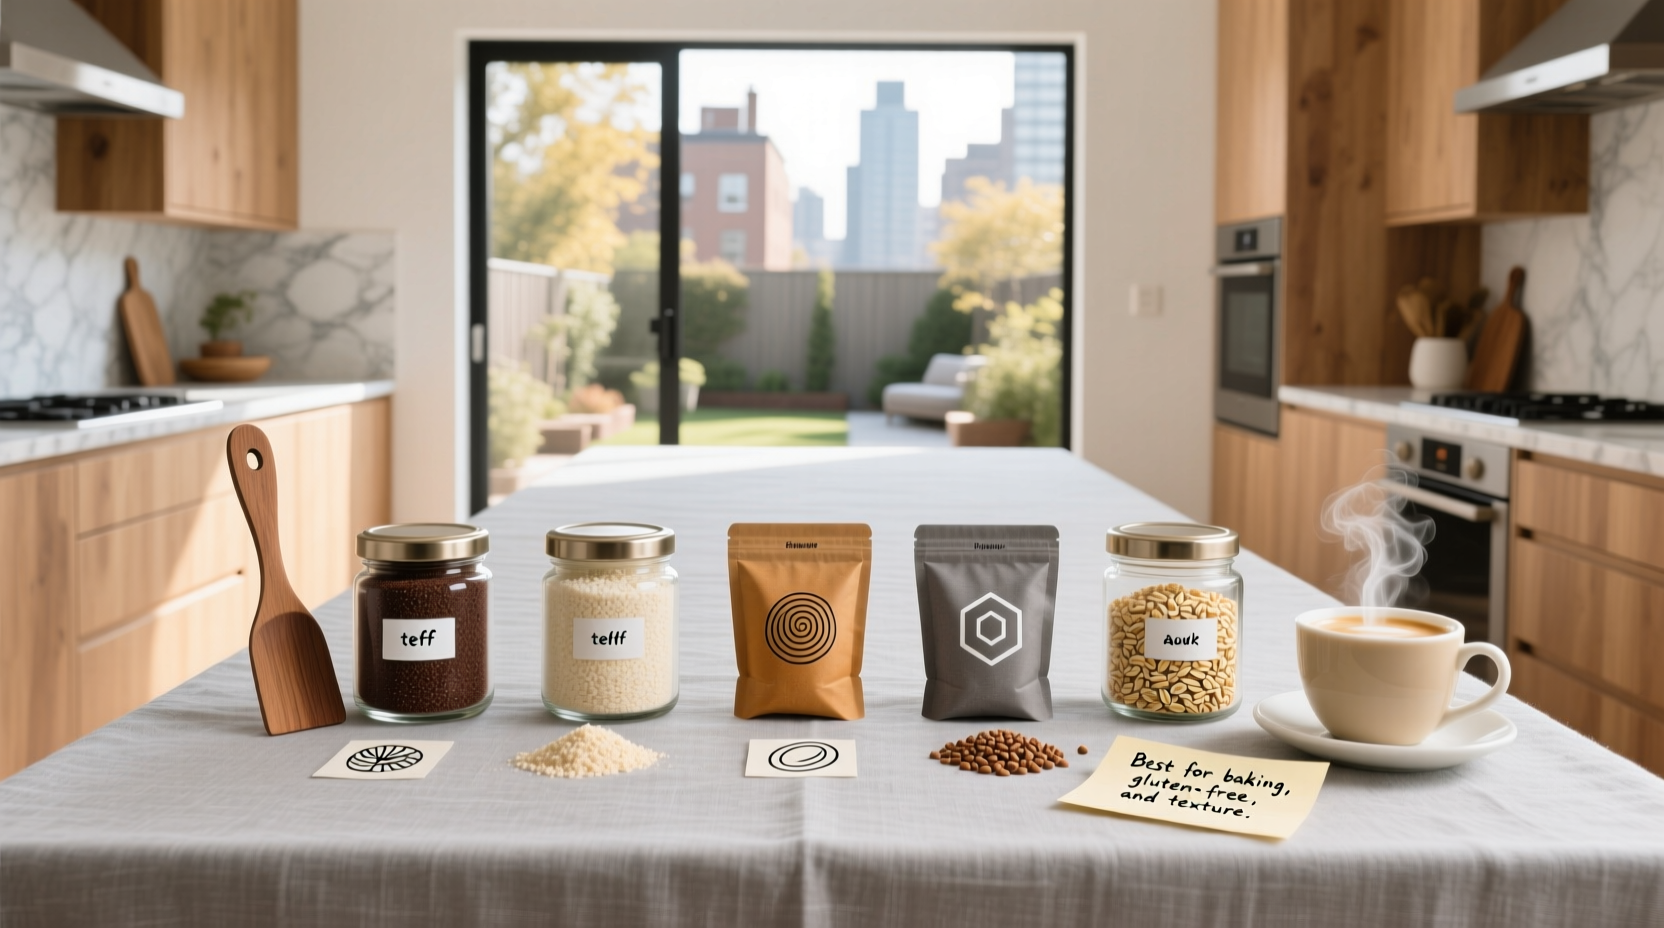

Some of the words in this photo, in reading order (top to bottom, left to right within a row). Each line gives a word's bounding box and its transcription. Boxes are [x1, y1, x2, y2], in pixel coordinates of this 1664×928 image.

[400, 629, 437, 647] teff
[1127, 773, 1257, 806] gluten-free,
[1130, 752, 1175, 773] Best
[1184, 761, 1214, 779] for
[1223, 768, 1291, 797] baking,
[1120, 790, 1159, 804] and
[1168, 794, 1250, 819] texture.
